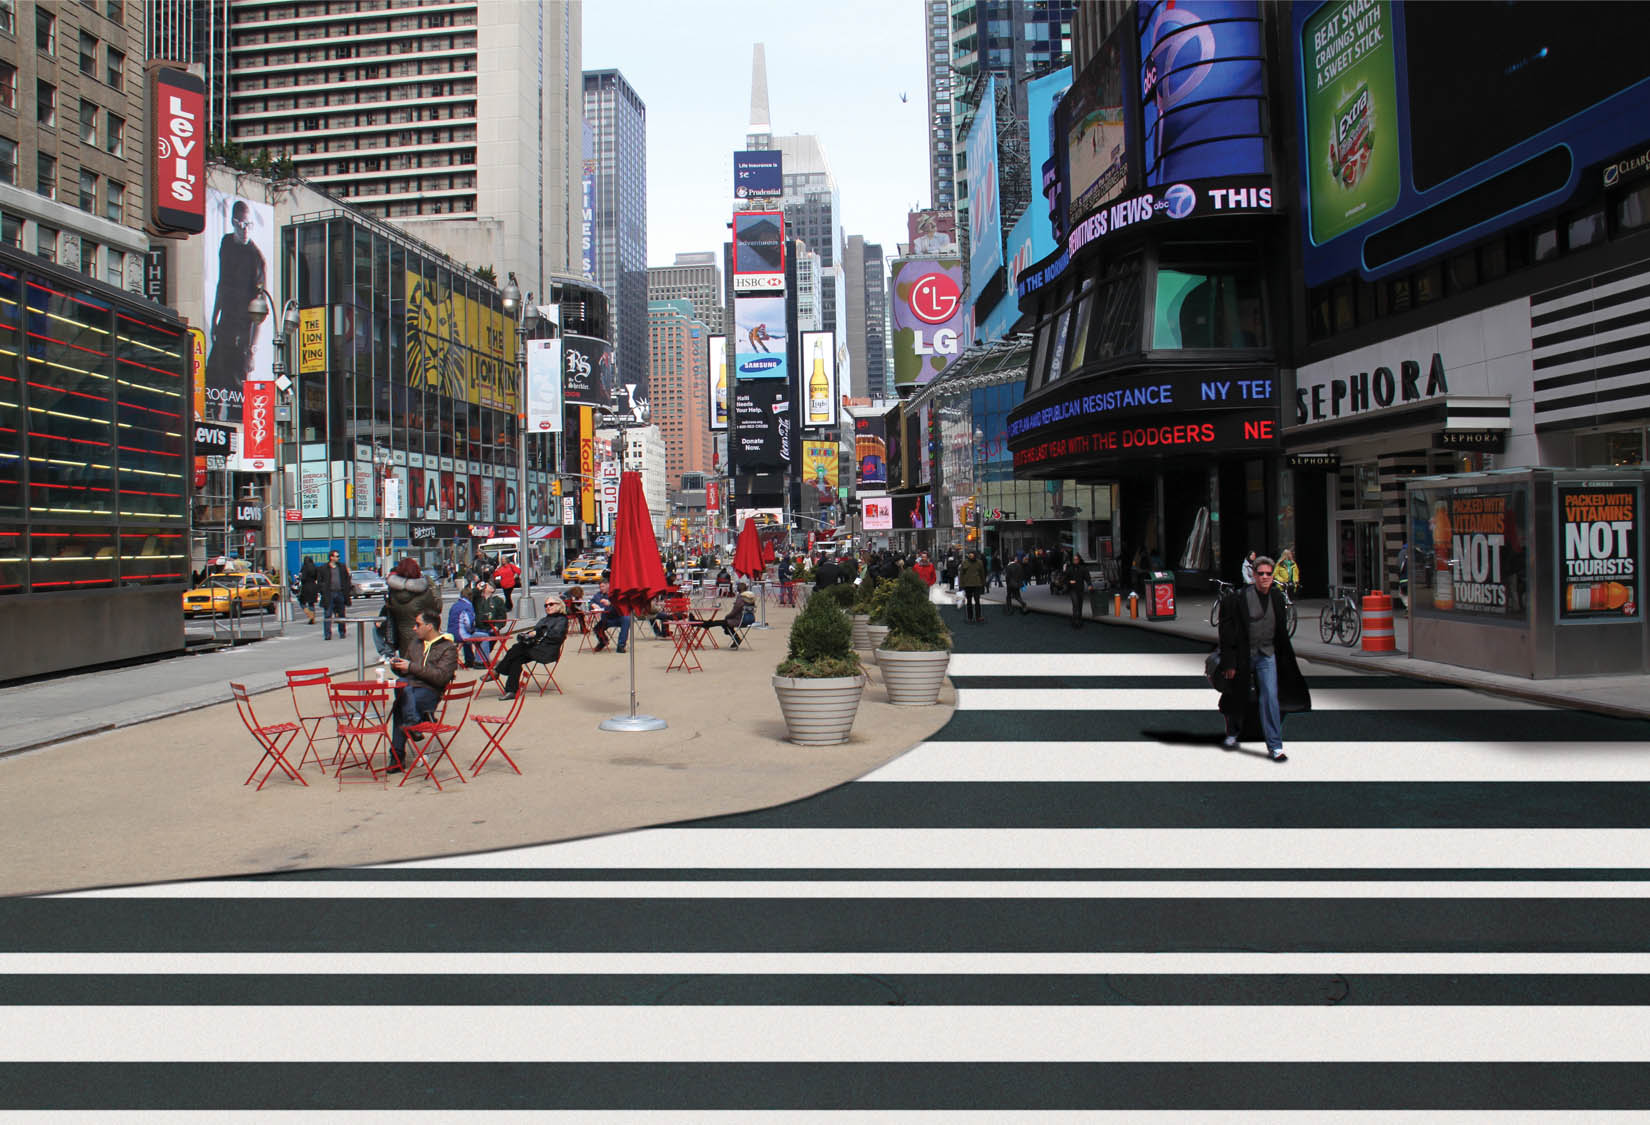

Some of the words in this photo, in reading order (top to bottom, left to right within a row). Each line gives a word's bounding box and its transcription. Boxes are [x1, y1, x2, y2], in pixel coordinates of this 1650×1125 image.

[1314, 15, 1339, 51] BEAT
[1342, 0, 1374, 28] SNAC
[1316, 26, 1354, 69] CRAVINGS
[1356, 5, 1381, 35] WITH
[1317, 72, 1323, 88] A
[1324, 47, 1353, 83] SWEET
[1355, 24, 1384, 59] STICK.
[1340, 90, 1368, 145] Extra
[748, 188, 781, 196] Prudential
[1110, 194, 1154, 232] NEWS
[1154, 200, 1170, 211] abc
[1208, 188, 1272, 209] THIS
[736, 278, 765, 288] HSBC
[1026, 271, 1043, 293] THE
[304, 320, 320, 329] THE
[303, 333, 322, 347] LION
[486, 326, 504, 349] THE
[914, 328, 958, 355] LG
[303, 349, 323, 365] KING
[470, 345, 497, 389] LION
[1296, 353, 1449, 425] SEPHORA
[1042, 399, 1080, 425] REPUBLICAN
[1082, 385, 1173, 414] RESISTANCE
[1201, 381, 1231, 401] NY
[1068, 436, 1088, 455] WITH
[1092, 430, 1118, 451] THE
[1123, 423, 1216, 448] DODGERS
[1244, 421, 1275, 440] NE
[1443, 433, 1498, 442] SEPHORA
[582, 438, 593, 493] Kodak
[1291, 457, 1337, 466] SEPHORA
[1453, 498, 1483, 513] PACKED
[1484, 497, 1505, 513] WITH
[1565, 493, 1605, 506] PACKED
[1606, 493, 1633, 506] WITH
[1453, 512, 1505, 534] VITAMINS
[1566, 505, 1633, 522] VITAMINS
[1565, 521, 1633, 560] NOT
[1453, 533, 1505, 584] NOT
[1566, 558, 1634, 576] TOURISTS
[1454, 583, 1506, 605] TOURISTS
